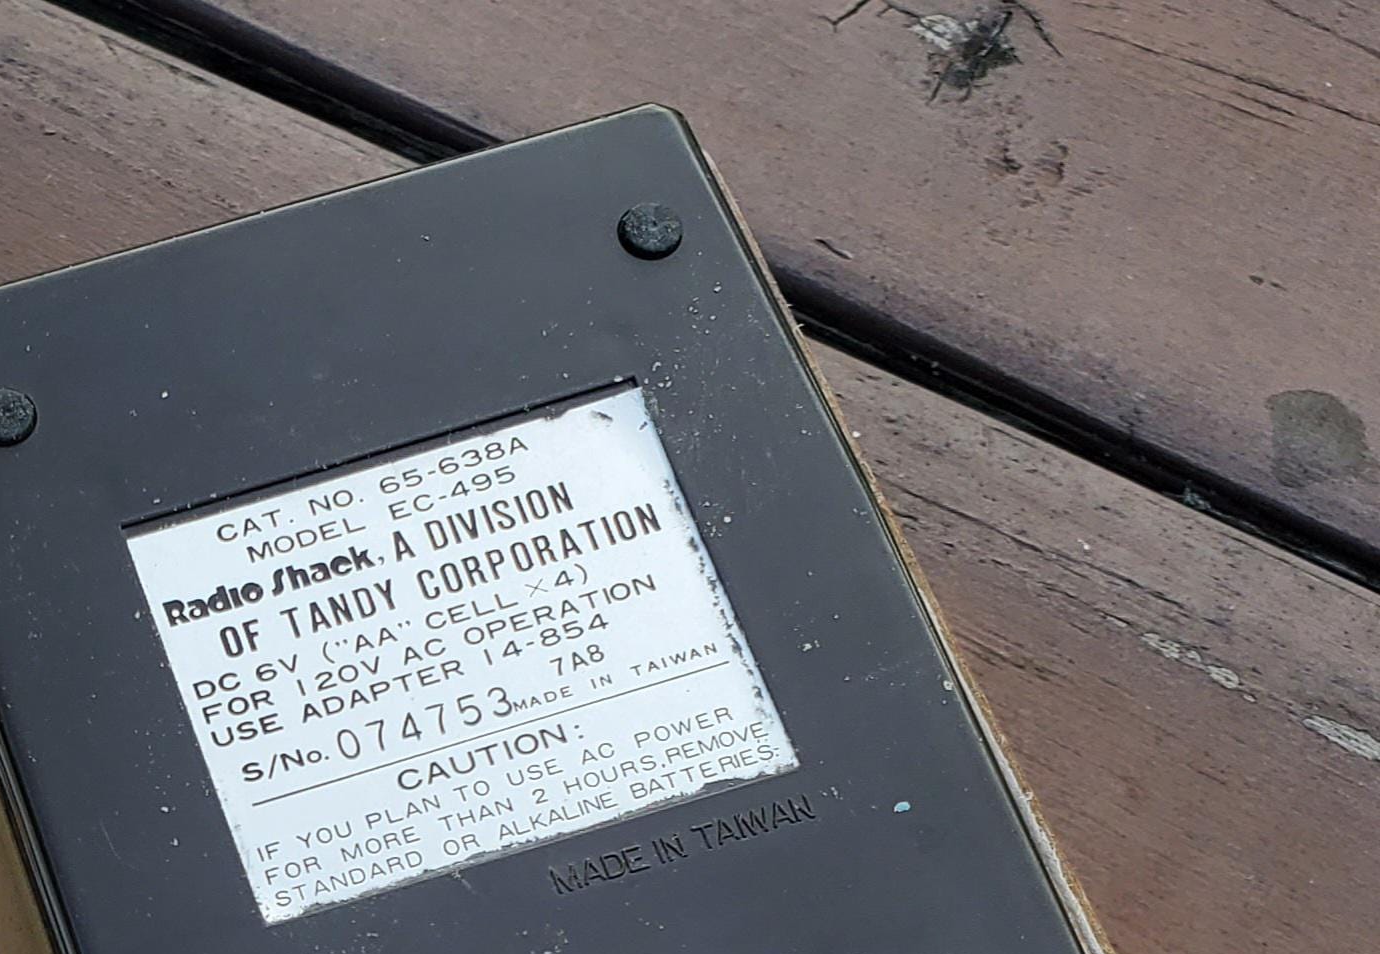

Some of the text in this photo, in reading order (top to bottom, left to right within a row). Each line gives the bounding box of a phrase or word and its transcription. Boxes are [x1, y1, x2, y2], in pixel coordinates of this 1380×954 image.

[216, 436, 529, 543] CAT. NO. 65-638A
[246, 465, 516, 564] MODEL EC-495
[162, 581, 264, 628] Radio
[392, 529, 417, 562] A
[424, 481, 575, 550] DIVISION
[219, 502, 662, 659] OF TANDY CORPORATION
[192, 672, 241, 701] DC
[255, 654, 299, 683] 6V
[424, 591, 519, 631] CELL
[202, 573, 657, 725] FOR 120V AC OPERATION
[210, 613, 610, 747] USE ADAPTER 14-854
[512, 641, 719, 713] MADE IN TAIWAN
[241, 643, 605, 782] S/No. 074753 7A8
[397, 723, 585, 790] CAUTION:
[256, 706, 735, 862] IF YOU PLAN TO USE AC POWER
[264, 856, 323, 886] FOR
[340, 826, 421, 862] MORE
[437, 797, 514, 833] THAN
[531, 787, 549, 805] 2
[274, 850, 424, 908] STANDARD
[442, 833, 481, 857] OR
[497, 791, 619, 841] ALKALINE
[548, 795, 816, 896] MADE IN TAIWAN
